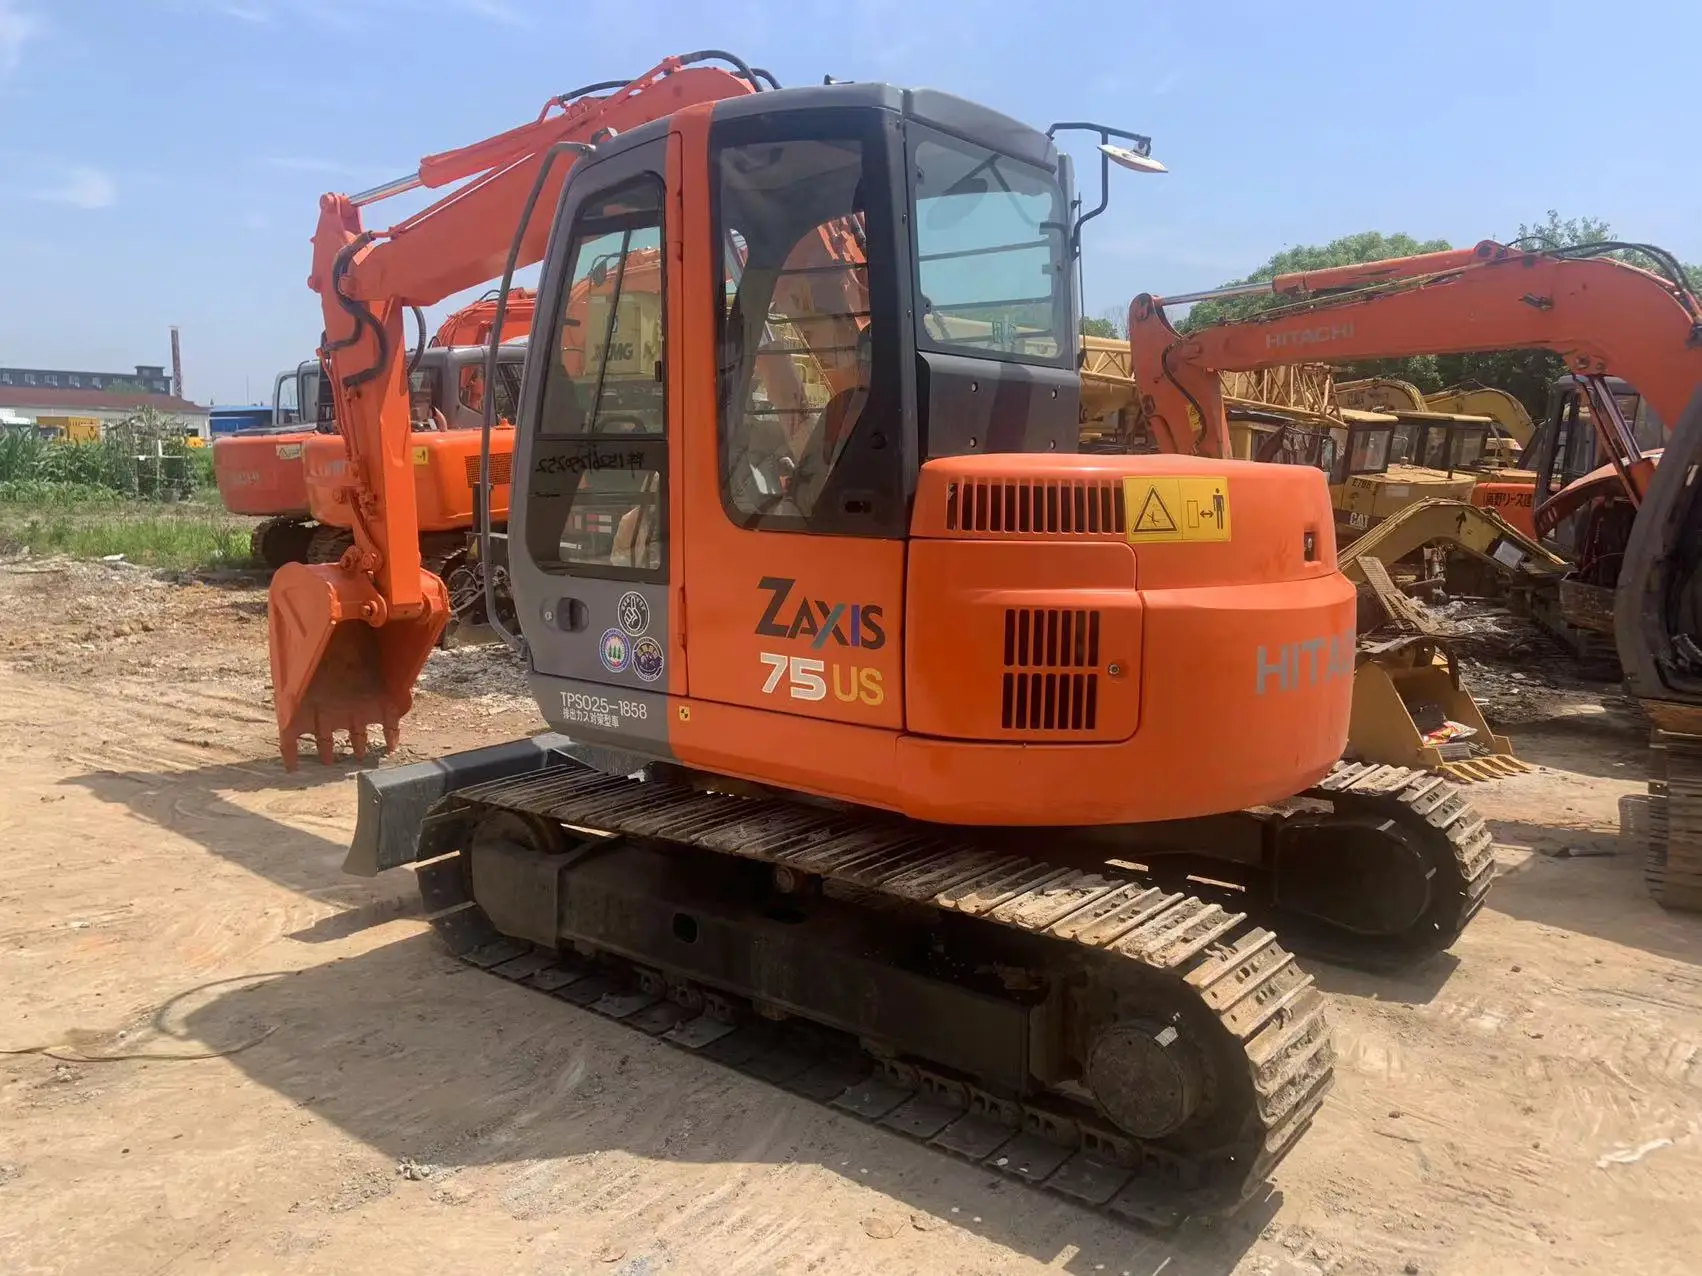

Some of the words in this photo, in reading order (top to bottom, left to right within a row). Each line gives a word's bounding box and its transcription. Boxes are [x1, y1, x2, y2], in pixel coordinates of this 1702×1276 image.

[1265, 323, 1354, 349] HITACHI
[1350, 512, 1369, 530] CAT
[754, 576, 886, 650] ZAXIS
[760, 651, 827, 701] 75
[832, 663, 884, 705] US
[1256, 627, 1356, 695] HITA
